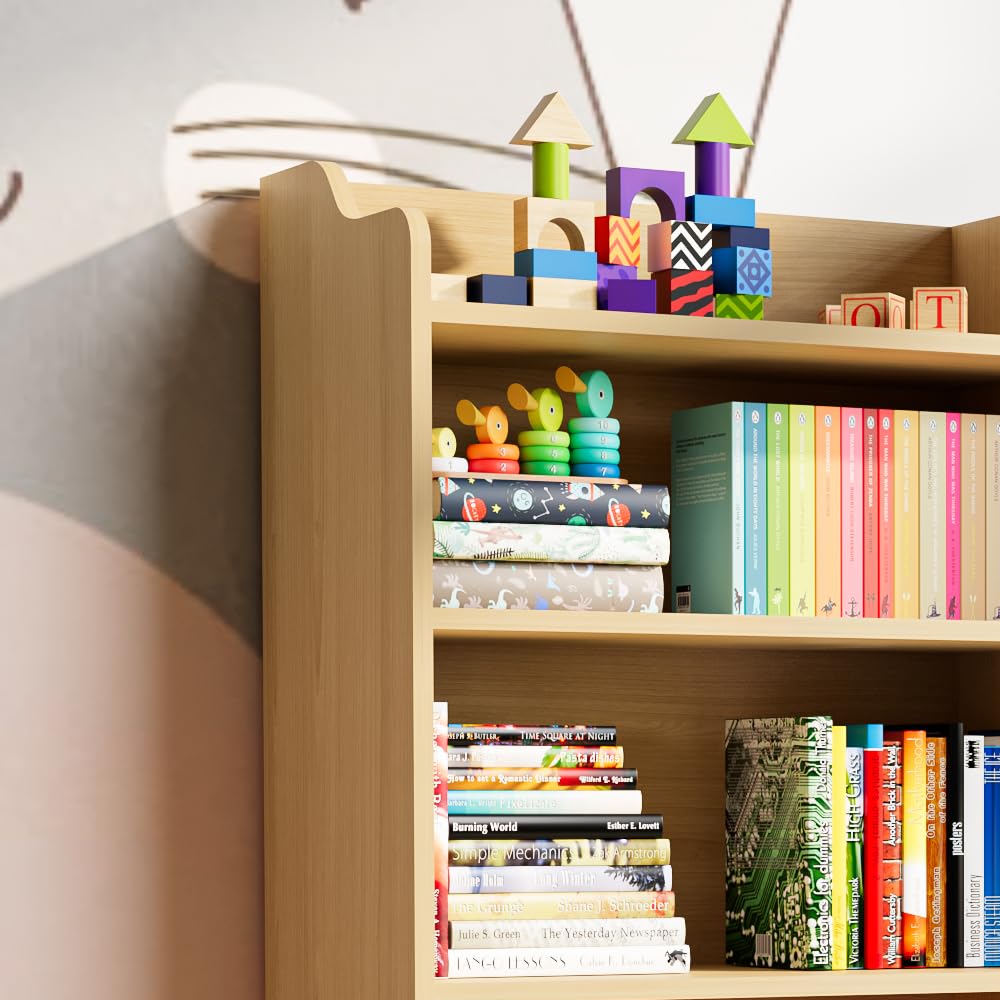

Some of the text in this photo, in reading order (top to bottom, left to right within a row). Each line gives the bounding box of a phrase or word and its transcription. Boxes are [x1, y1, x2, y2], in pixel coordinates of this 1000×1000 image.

[926, 296, 953, 328] T
[500, 462, 507, 473] 2
[601, 466, 608, 477] 7
[520, 731, 540, 740] TIME
[542, 731, 573, 742] SQUARE
[588, 731, 614, 741] NIGHT
[887, 746, 896, 765] Wall
[926, 742, 936, 767] Side
[816, 759, 828, 793] Donald
[845, 753, 862, 798] GRASS
[926, 769, 936, 801] Other
[938, 757, 946, 789] Fence
[887, 790, 896, 811] Brick
[926, 803, 936, 821] the
[938, 791, 946, 809] the
[452, 821, 660, 835] Burning World Esther E. Lovett
[846, 804, 861, 842] HIGH
[887, 812, 896, 846] Another
[926, 823, 936, 839] On
[813, 821, 829, 875] dummies
[950, 821, 964, 856] posters
[452, 845, 667, 864] Simple Mechanics Armstrong
[813, 877, 829, 896] for
[608, 897, 670, 912] Schroeder
[966, 874, 983, 958] Business Dictionary
[458, 929, 480, 941] Julie
[493, 929, 521, 940] Green
[542, 927, 562, 939] The
[564, 926, 616, 943] Yesterday
[619, 926, 679, 942] Newspaper
[813, 899, 830, 966] Electronics
[848, 927, 859, 965] VICTORIA
[932, 927, 943, 963] Joseph
[887, 934, 897, 965] William
